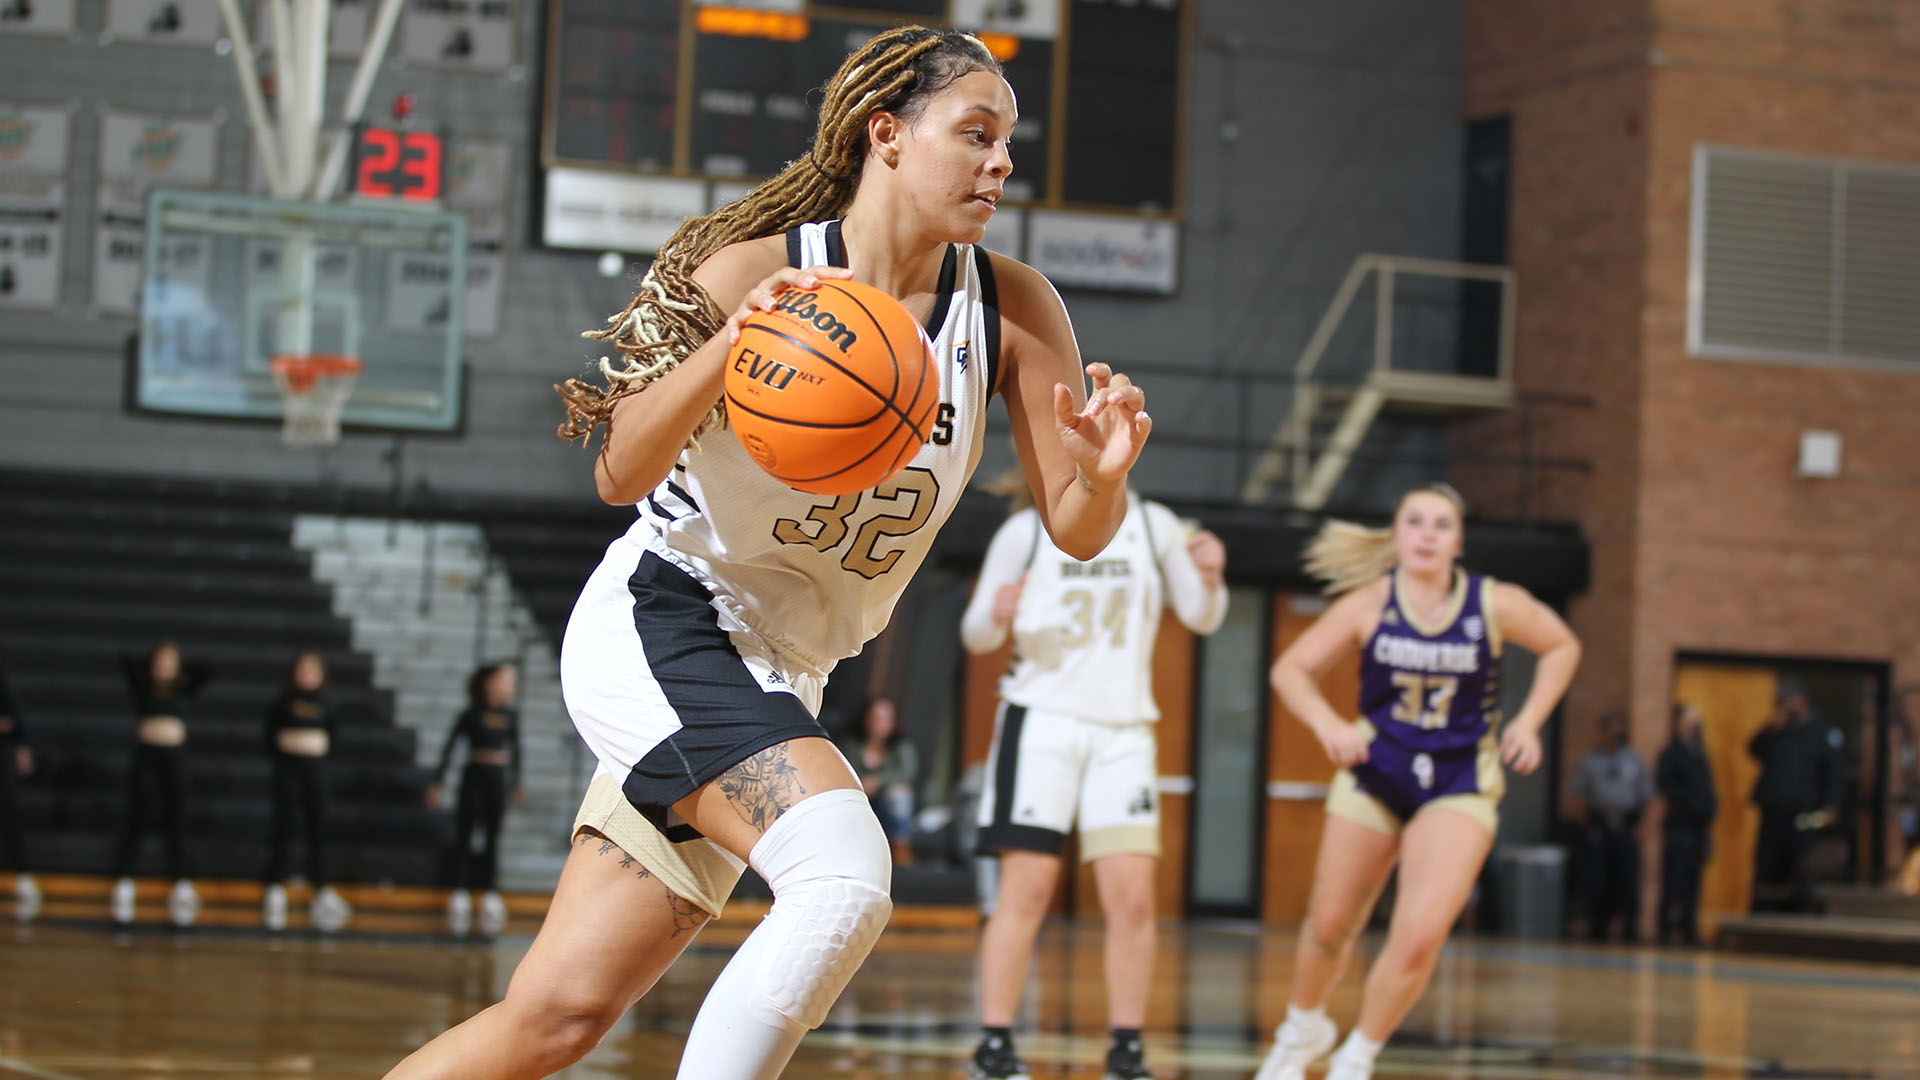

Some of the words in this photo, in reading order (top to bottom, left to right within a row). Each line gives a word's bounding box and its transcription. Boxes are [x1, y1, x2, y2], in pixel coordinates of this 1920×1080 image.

[357, 127, 442, 203] 23
[776, 287, 857, 354] ilson
[734, 348, 797, 390] EVO
[797, 371, 826, 386] NXT
[772, 466, 941, 580] 32
[1060, 587, 1127, 648] 34
